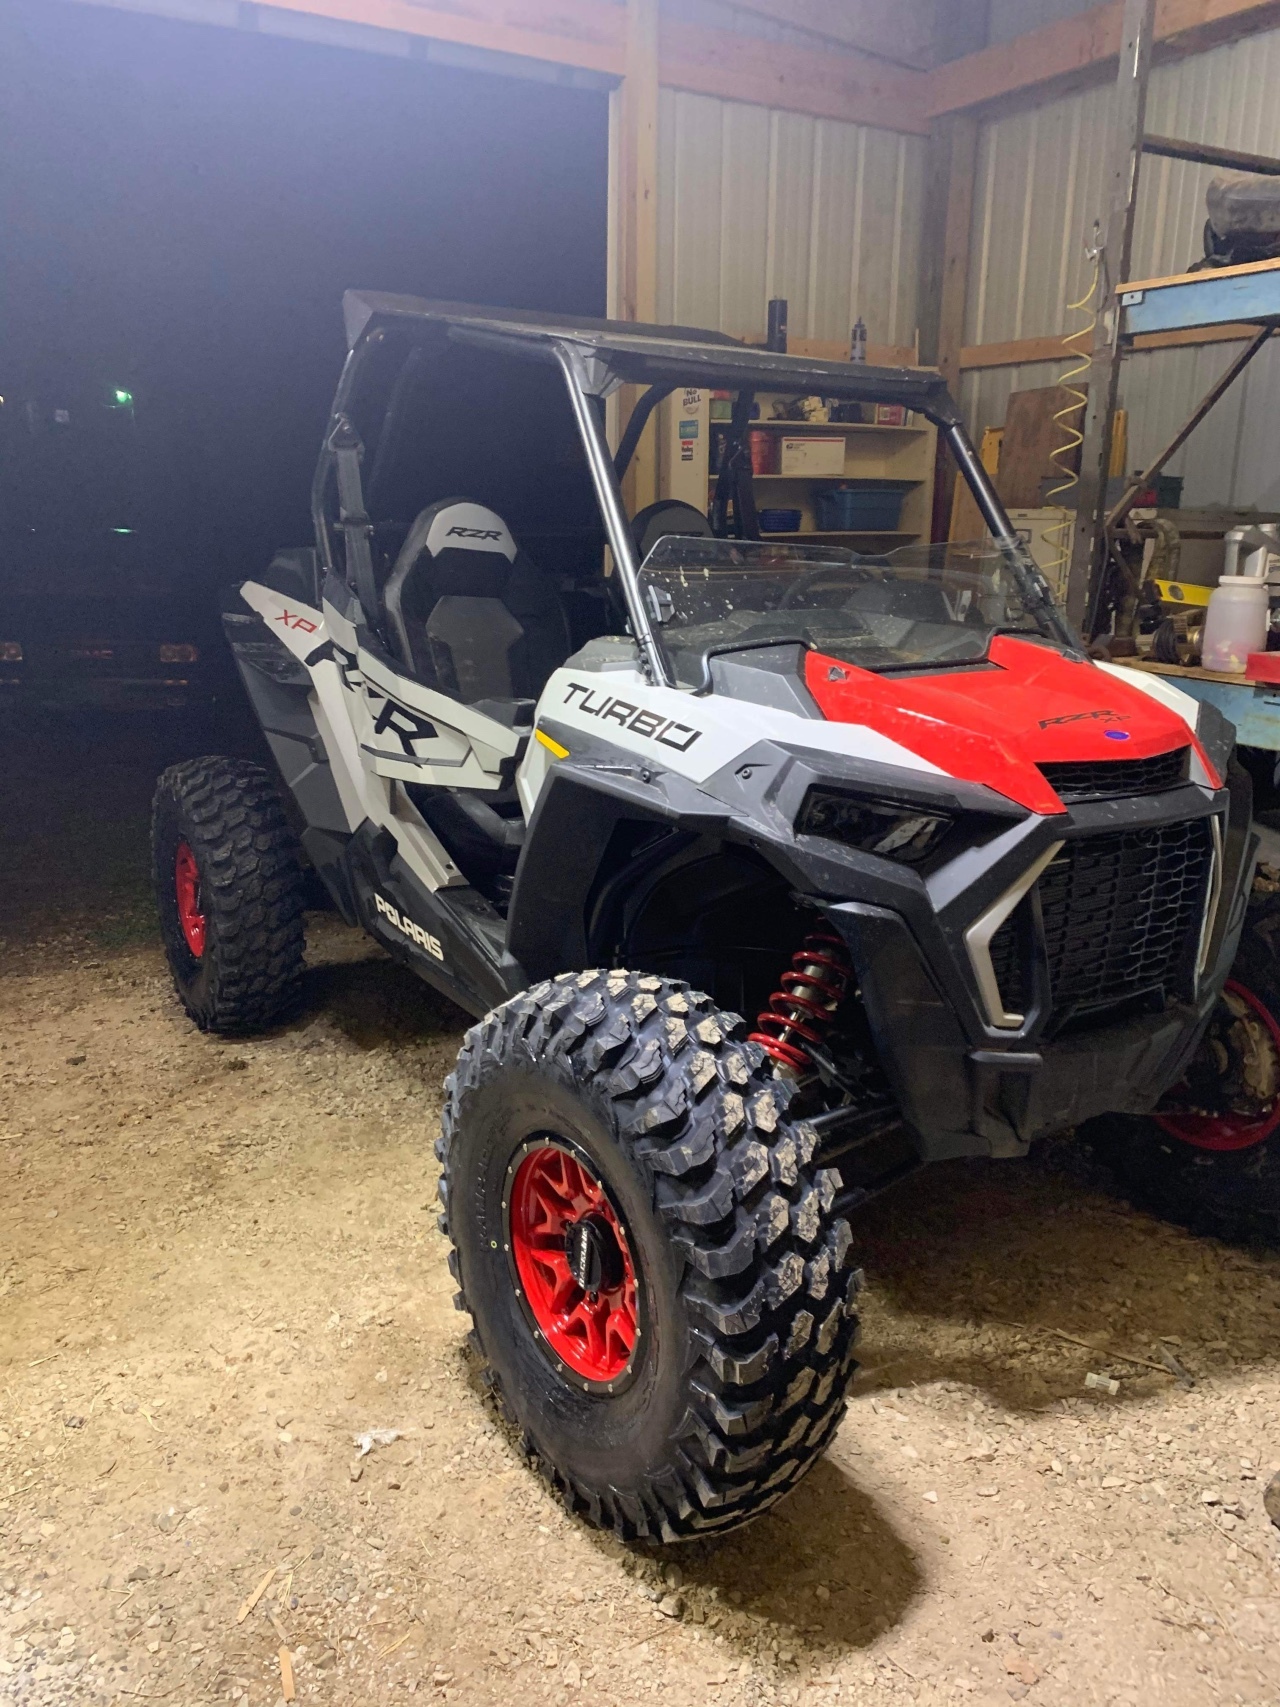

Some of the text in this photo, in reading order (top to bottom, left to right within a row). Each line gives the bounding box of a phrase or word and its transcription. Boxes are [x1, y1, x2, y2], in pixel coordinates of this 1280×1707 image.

[682, 395, 702, 406] BULL
[445, 526, 503, 541] RZR
[274, 609, 318, 634] XP
[563, 682, 703, 753] TURBO
[1038, 710, 1118, 729] RZR
[374, 892, 444, 961] POLARIS
